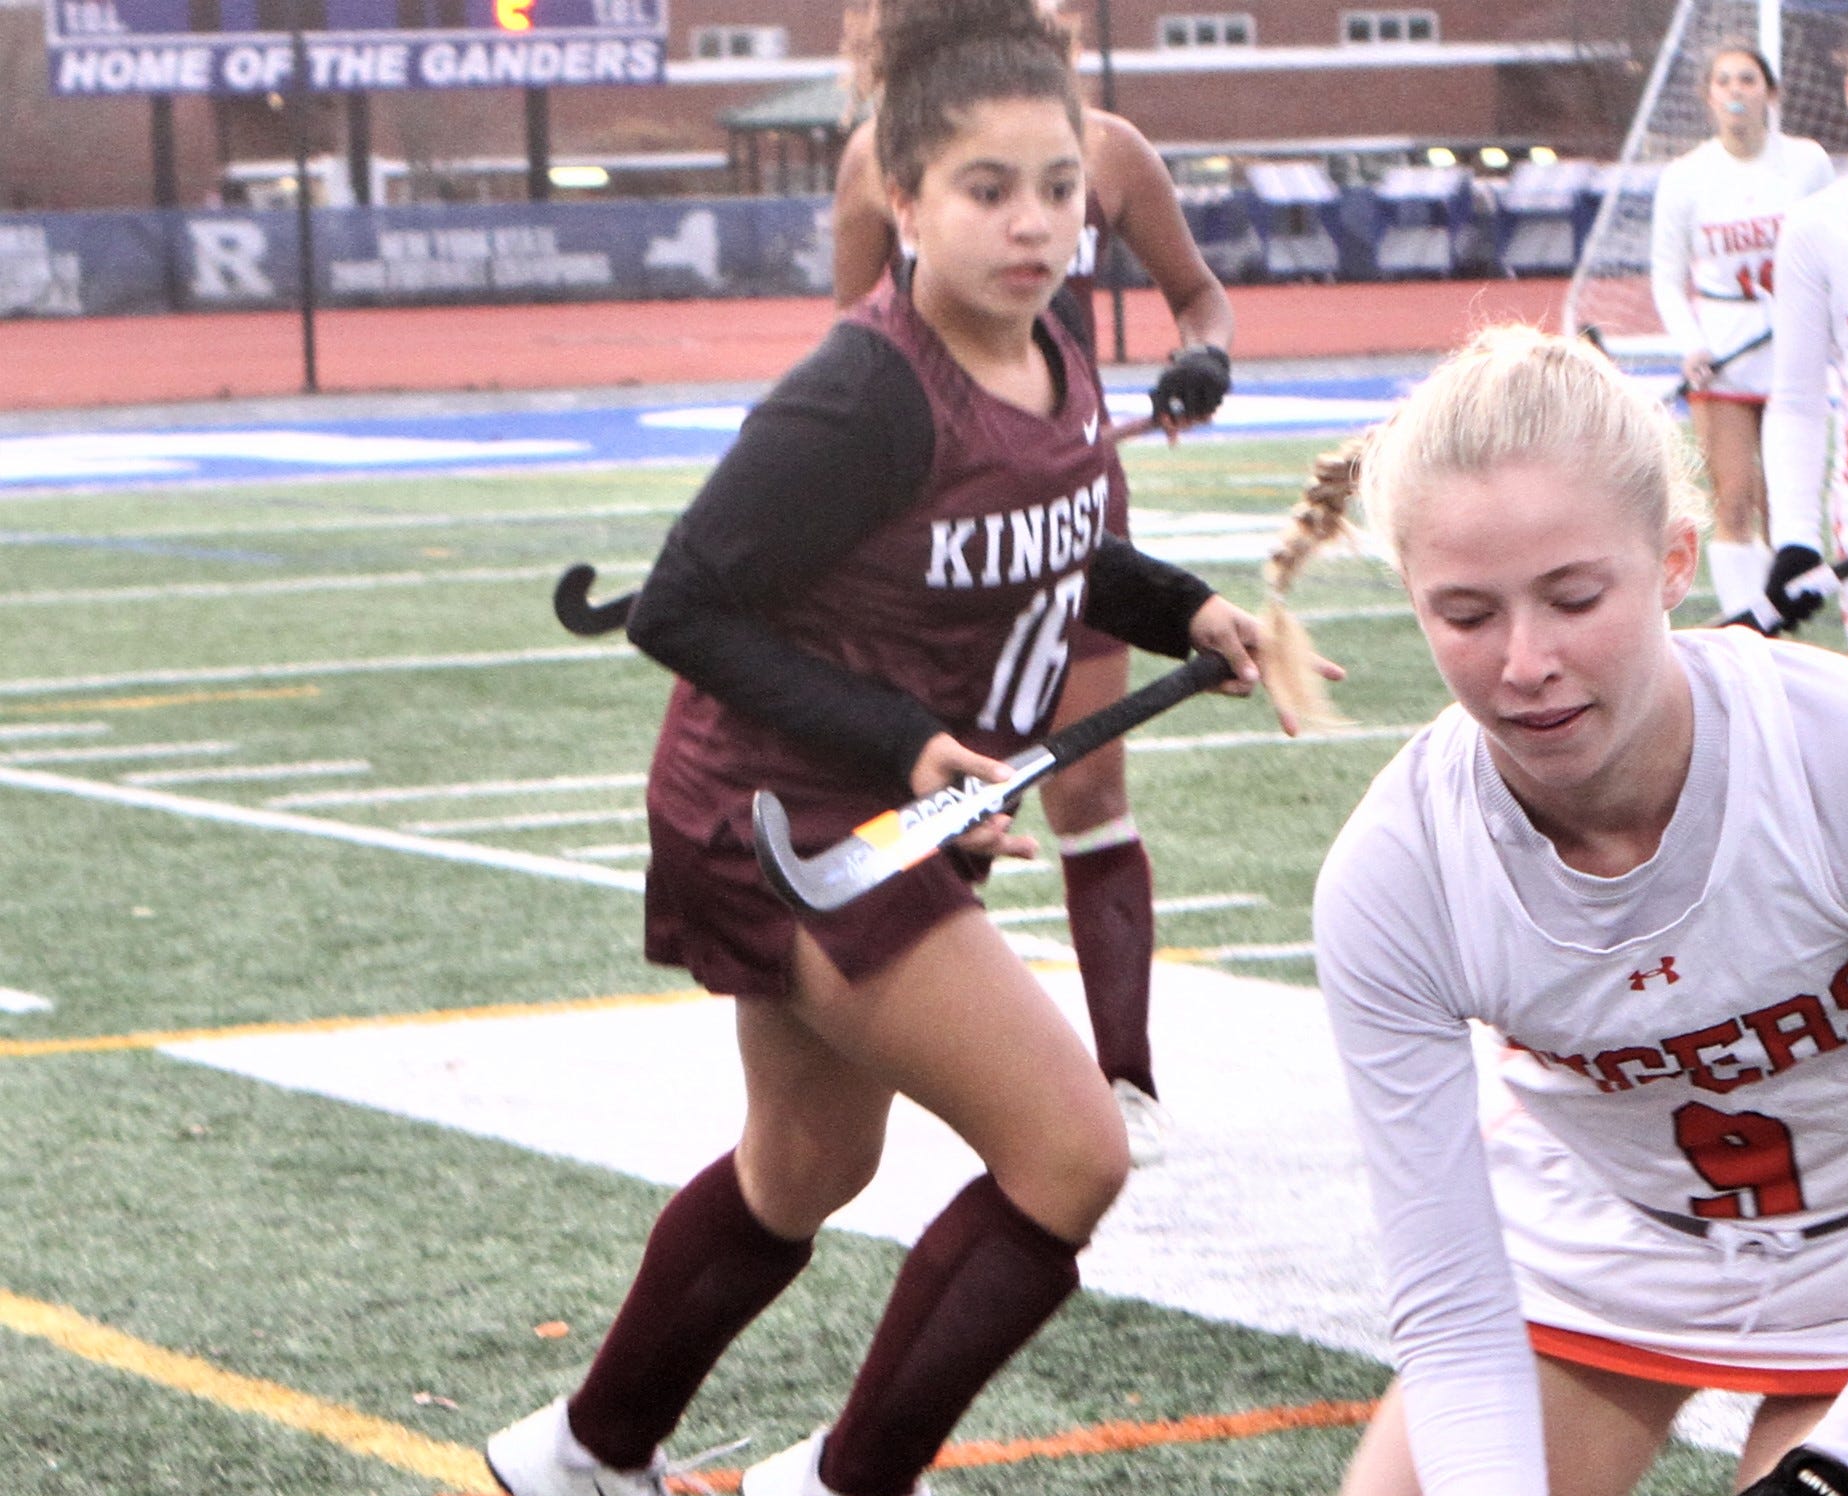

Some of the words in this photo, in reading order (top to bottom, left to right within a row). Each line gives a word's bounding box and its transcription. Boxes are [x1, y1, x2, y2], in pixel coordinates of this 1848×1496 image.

[58, 47, 212, 92] HOME
[222, 46, 294, 91] OF
[305, 45, 406, 88] THE
[419, 39, 658, 86] GANDERS
[186, 218, 275, 299] R
[976, 569, 1085, 736] 16
[1671, 1099, 1807, 1220] 9
